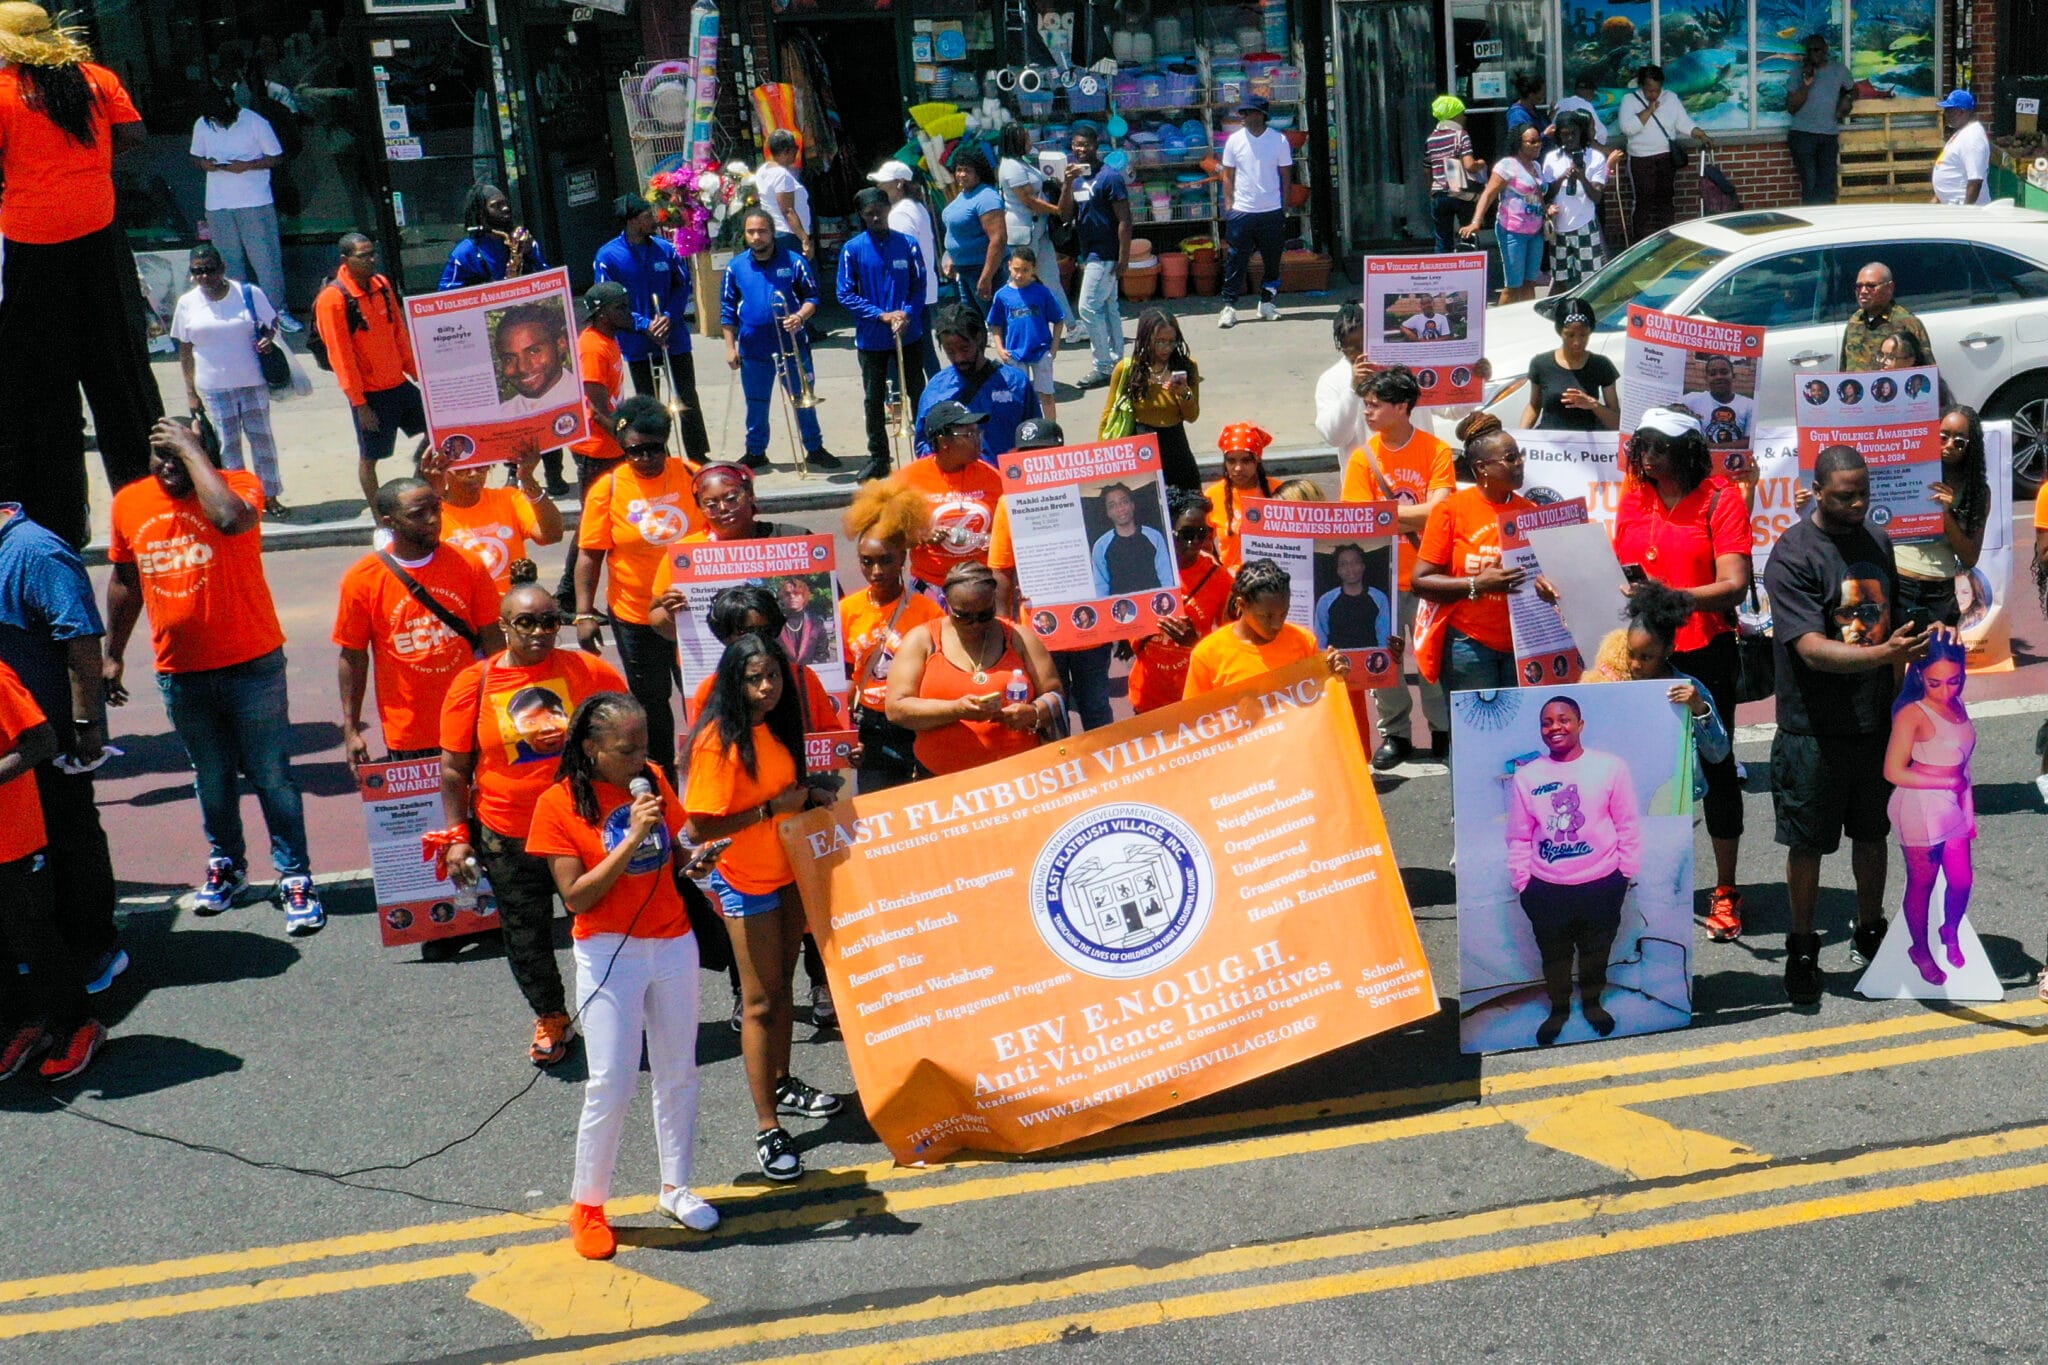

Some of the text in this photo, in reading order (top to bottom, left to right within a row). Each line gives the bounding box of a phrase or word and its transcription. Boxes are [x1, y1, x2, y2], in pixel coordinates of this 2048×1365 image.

[1475, 42, 1501, 56] OPEN
[1370, 259, 1482, 271] GUN VIOLENCE AWARENESS MONTH
[414, 278, 562, 314] GUN VIOLENCE AWARENESS MONTH
[1644, 327, 1741, 353] AWARENESS MONTH
[1645, 313, 1742, 343] GUN VIOLENCE
[1809, 427, 1929, 442] GUN VIOLENCE AWARENESS
[1856, 440, 1901, 453] ADVOCACY
[1903, 438, 1921, 450] DAY
[1023, 444, 1135, 474] GUN VIOLENCE
[1529, 449, 1577, 463] Black,
[1764, 447, 1776, 458] &
[1888, 453, 1906, 462] 2024
[1025, 459, 1137, 486] AWARENESS MONTH
[1050, 501, 1075, 510] Brown
[1263, 504, 1374, 523] GUN VIOLENCE
[1517, 504, 1580, 530] GUN VIOLENCE
[147, 533, 196, 551] PROJECT
[1263, 522, 1374, 534] AWARENESS MONTH
[137, 543, 213, 574] ECHO
[692, 542, 809, 564] GUN VIOLENCE
[694, 557, 810, 576] AWARENESS MONTH
[1283, 551, 1307, 560] Brown
[430, 587, 467, 609] VIOLENCE
[385, 766, 421, 782] GUN
[806, 677, 1329, 860] EAST FLATBUSH VILLAGE, INC.
[865, 721, 1285, 860] ENRICHING THE LIVES OF CHILDREN TO HAVE A COLORFUL FUTURE
[1208, 778, 1277, 810] Educating
[1216, 788, 1316, 833] Neighborhoods
[1223, 814, 1316, 855] Organizations
[1036, 807, 1201, 915] YOUTH AND COMMUNITY DEVELOPMENT ORGANIZATION
[1048, 819, 1186, 901] EAST FLATBUSH VILLAGE, INC.
[1231, 839, 1308, 877] Undeserved
[1239, 843, 1383, 900] Grassroots-Organizing
[830, 866, 1015, 931] Cultural Enrichment Programs
[1247, 870, 1378, 923] Health Enrichment
[840, 912, 959, 960] Anti-Violence March
[1078, 942, 1091, 955] THE
[1090, 948, 1110, 961] LIVES
[1110, 951, 1120, 961] OF
[1120, 945, 1152, 961] CHILDREN
[1152, 940, 1163, 952] TO
[1162, 928, 1177, 946] HAVE
[848, 953, 924, 989] Resource Fair
[926, 964, 995, 993] Workshops
[1355, 967, 1425, 999] Supportive
[1361, 957, 1405, 981] School
[865, 971, 1073, 1047] Community Engagement Programs
[990, 940, 1296, 1063] EFV E.N.O.U.G.H.
[1369, 985, 1421, 1009] Services
[973, 960, 1332, 1097] Anti-Violence Initiatives
[976, 1083, 1050, 1110] Academics,
[1093, 1047, 1154, 1075] Athletics
[1158, 1036, 1183, 1052] and
[1187, 1007, 1265, 1041] Community
[1268, 979, 1344, 1012] Organizing
[1017, 1014, 1320, 1128] WWW.EASTFLATBUSHVILLAGE.ORG
